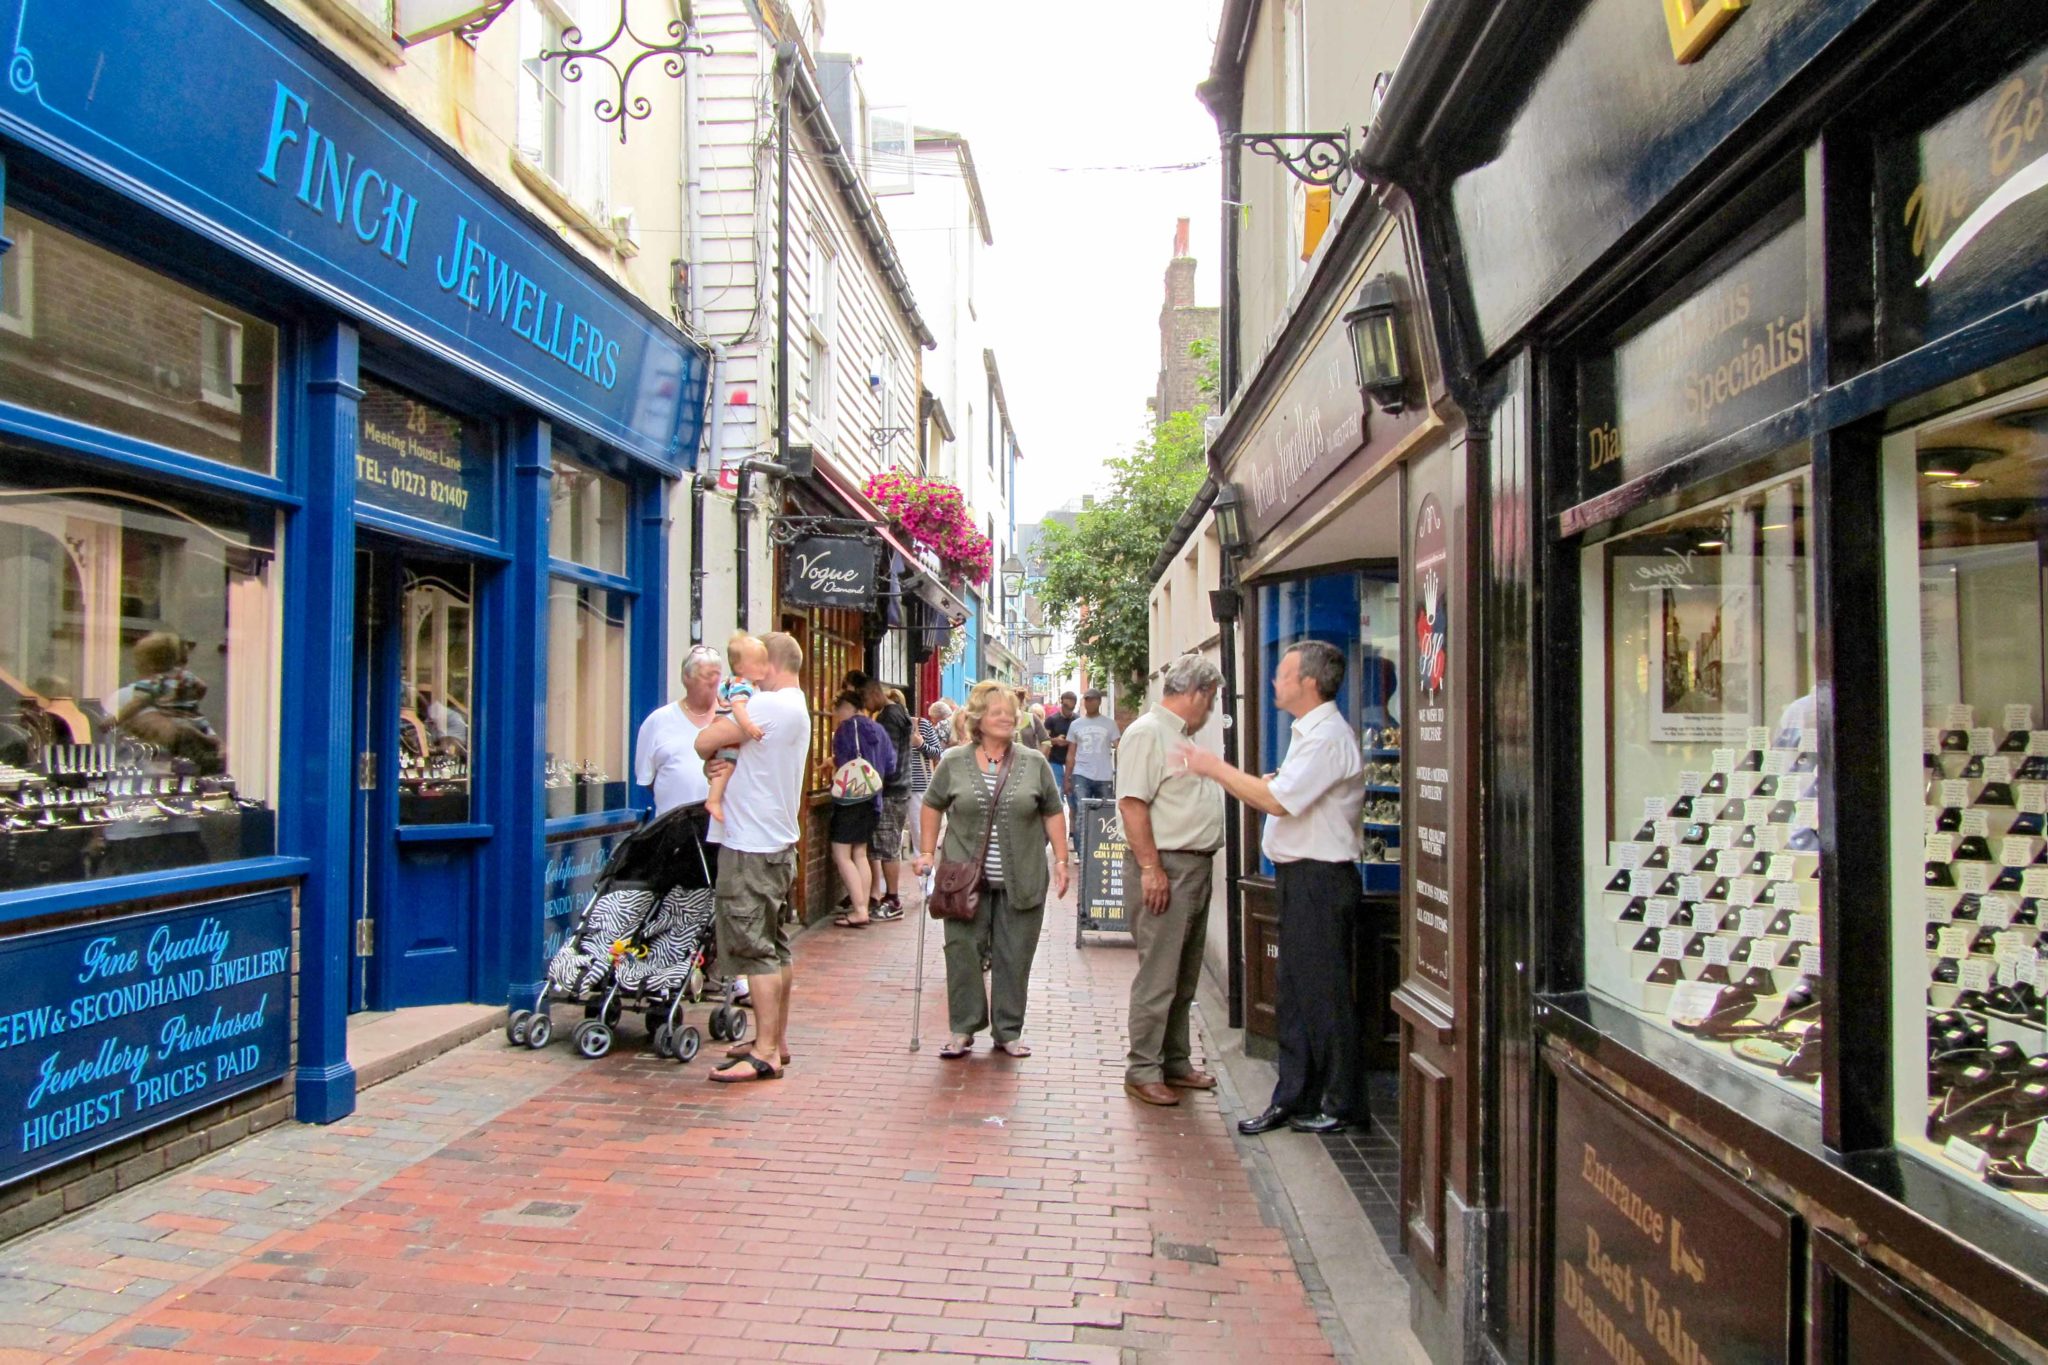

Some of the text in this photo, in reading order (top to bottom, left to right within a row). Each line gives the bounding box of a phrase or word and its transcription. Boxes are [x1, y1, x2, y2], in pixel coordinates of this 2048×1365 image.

[258, 80, 620, 390] FINCH JEWELLERS
[365, 420, 461, 472] Meeting House Lane
[406, 400, 427, 434] 28
[355, 454, 469, 510] TEL: 01273 821407
[796, 550, 859, 590] Vogue
[1098, 816, 1120, 840] Vog
[79, 917, 229, 983] Fine Quality
[51, 1009, 66, 1034] &
[70, 969, 204, 1029] SECONDHAND
[205, 947, 289, 993] JEWELLERY
[28, 993, 268, 1109] Jewellery Purchased
[22, 1045, 260, 1153] HIGHEST PRICES PAID
[1582, 1142, 1664, 1244] Entrance
[1586, 1224, 1635, 1314] Best
